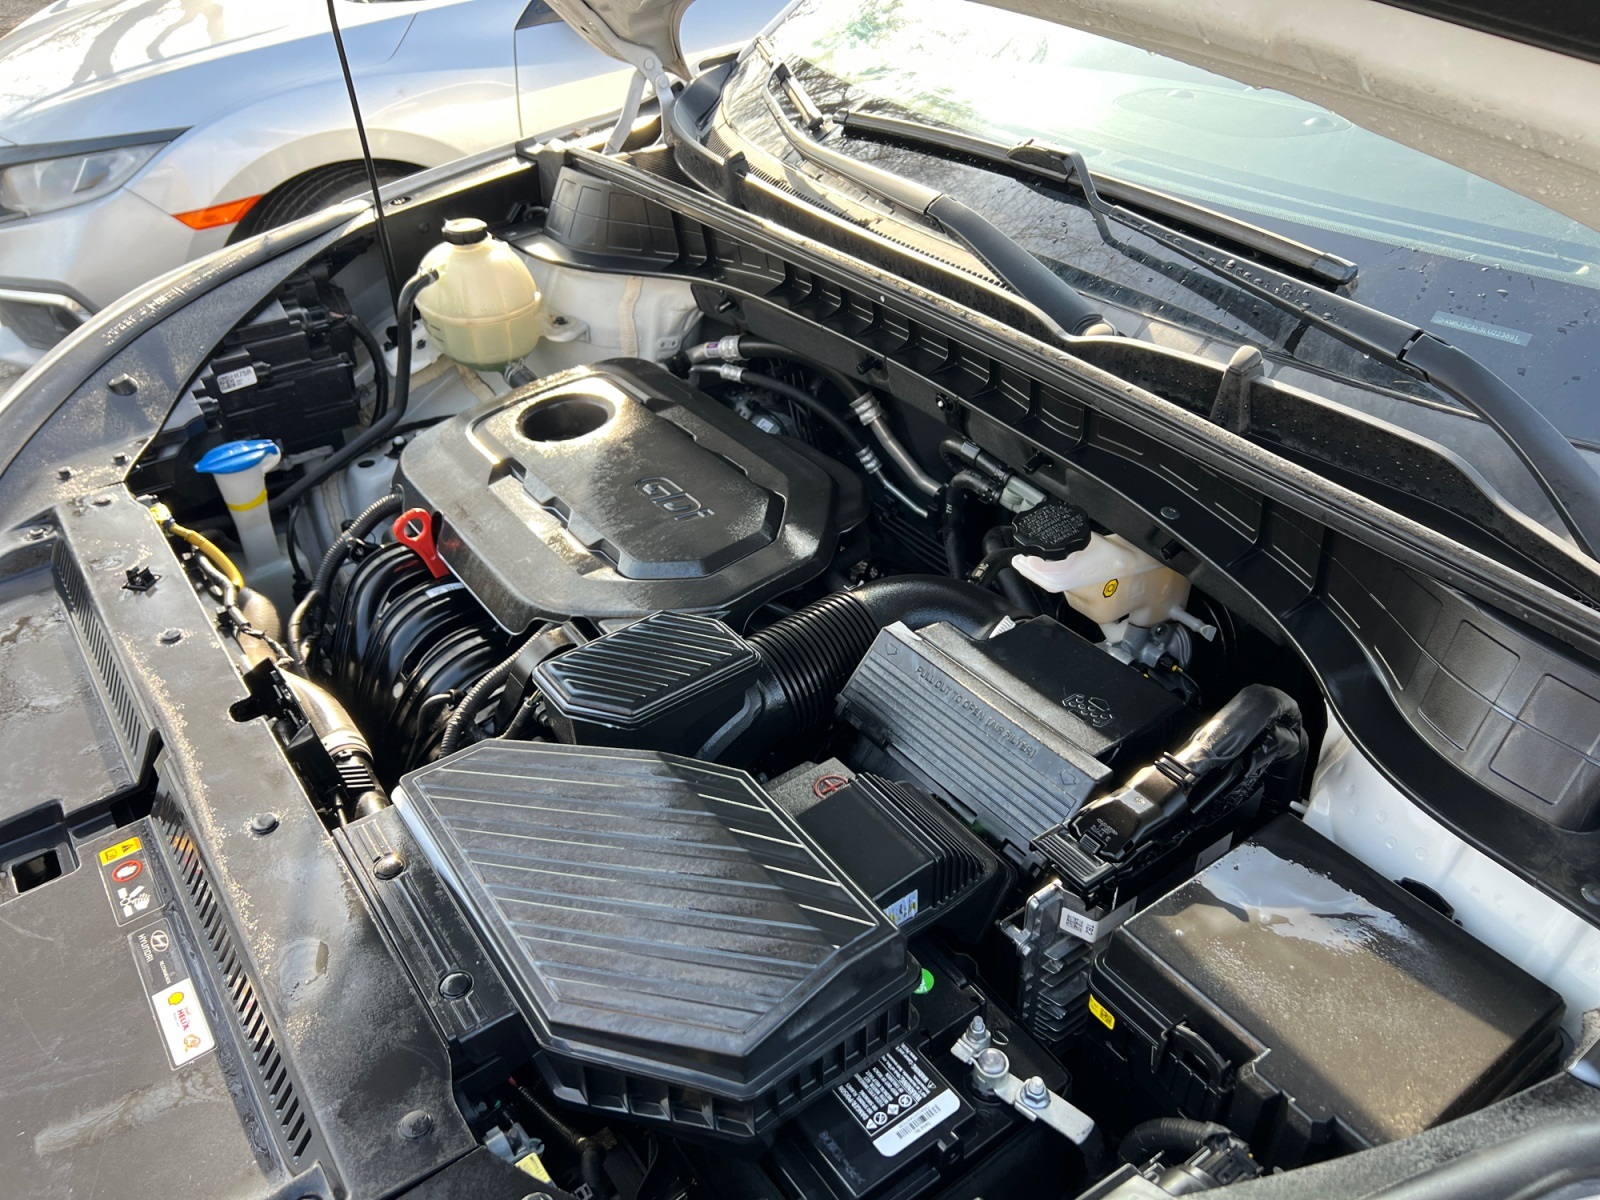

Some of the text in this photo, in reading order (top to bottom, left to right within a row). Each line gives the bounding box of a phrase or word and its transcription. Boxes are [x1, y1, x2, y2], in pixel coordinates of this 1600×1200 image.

[915, 666, 1036, 758] PULL OUT TO OPEN (AIR FILTER)
[138, 934, 154, 962] HYUNDAI
[177, 1009, 190, 1031] HELIX
[836, 1084, 869, 1120] DANGER/POISON
